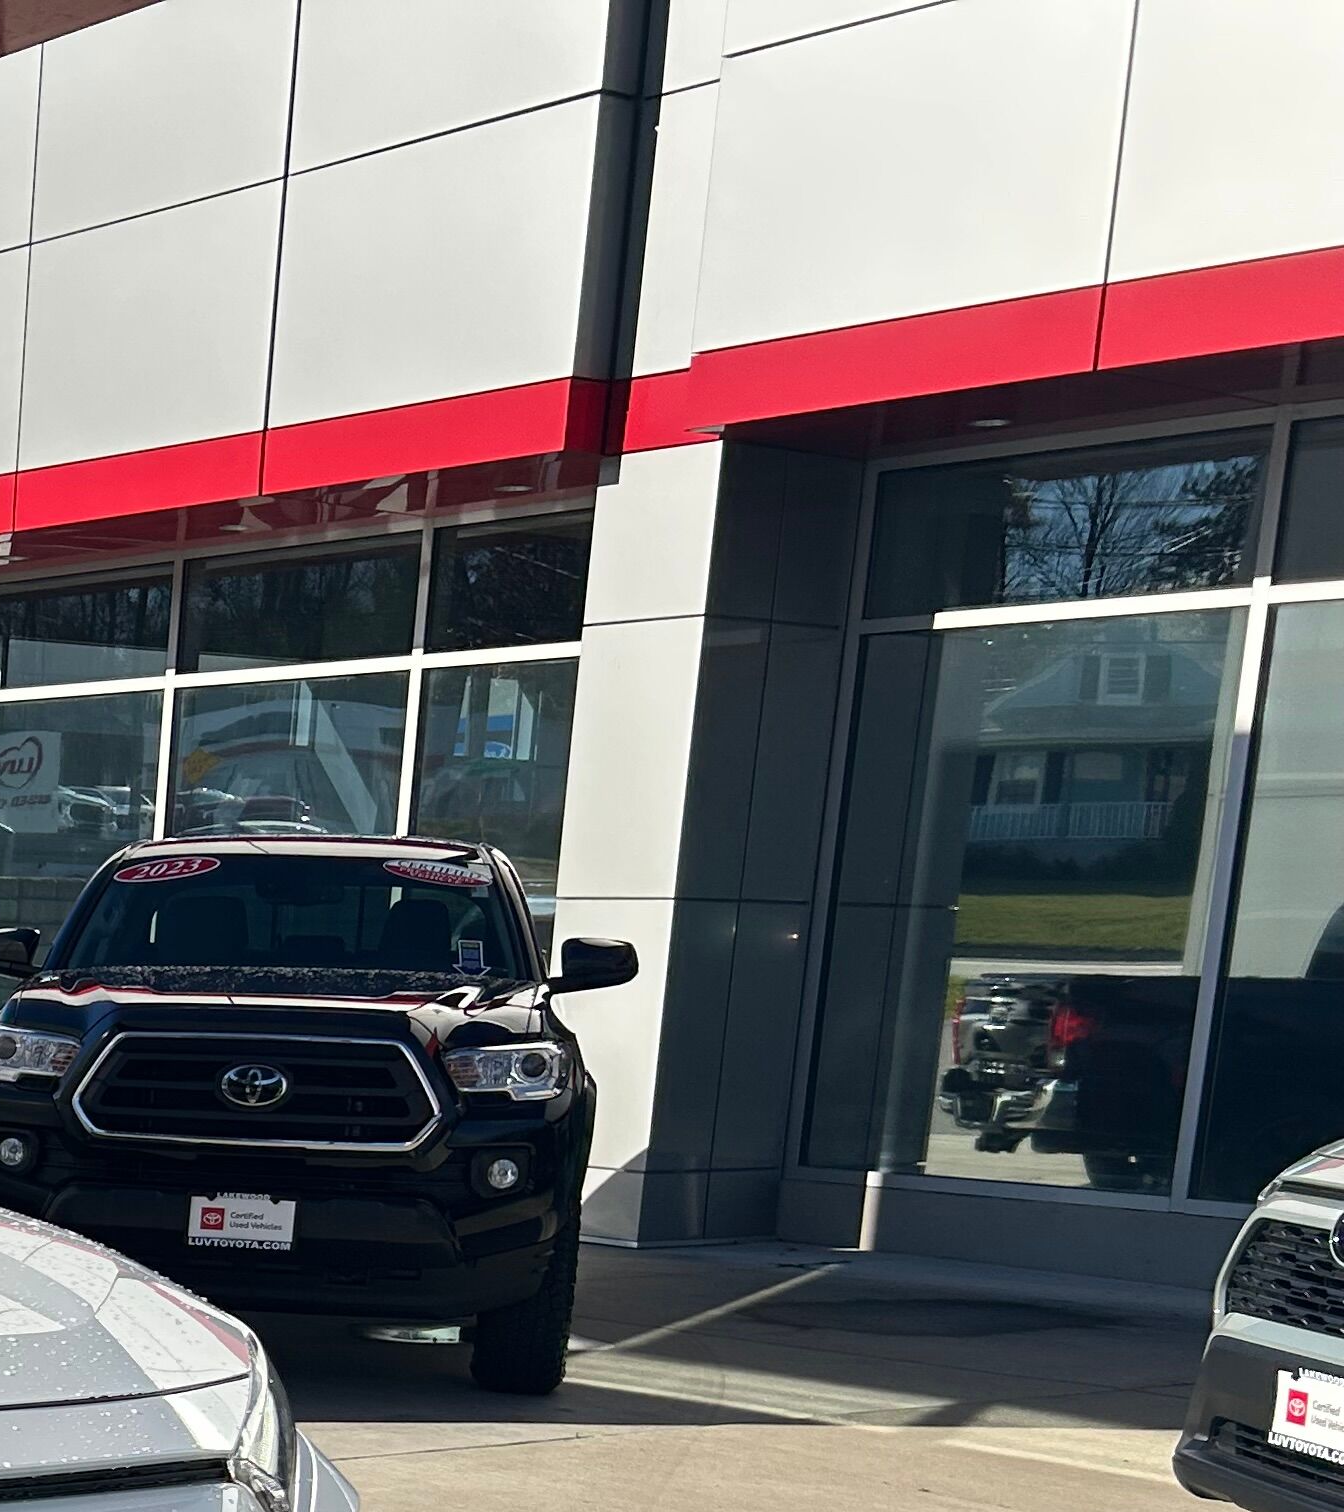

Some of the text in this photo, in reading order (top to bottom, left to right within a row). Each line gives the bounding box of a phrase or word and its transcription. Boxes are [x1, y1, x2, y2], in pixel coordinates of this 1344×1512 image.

[132, 859, 203, 880] 2023
[216, 1191, 271, 1201] LAKEWOOD
[230, 1211, 265, 1220] Certified
[229, 1220, 283, 1231] Used Vehicles
[187, 1237, 292, 1251] LUVTOYOTA.COM
